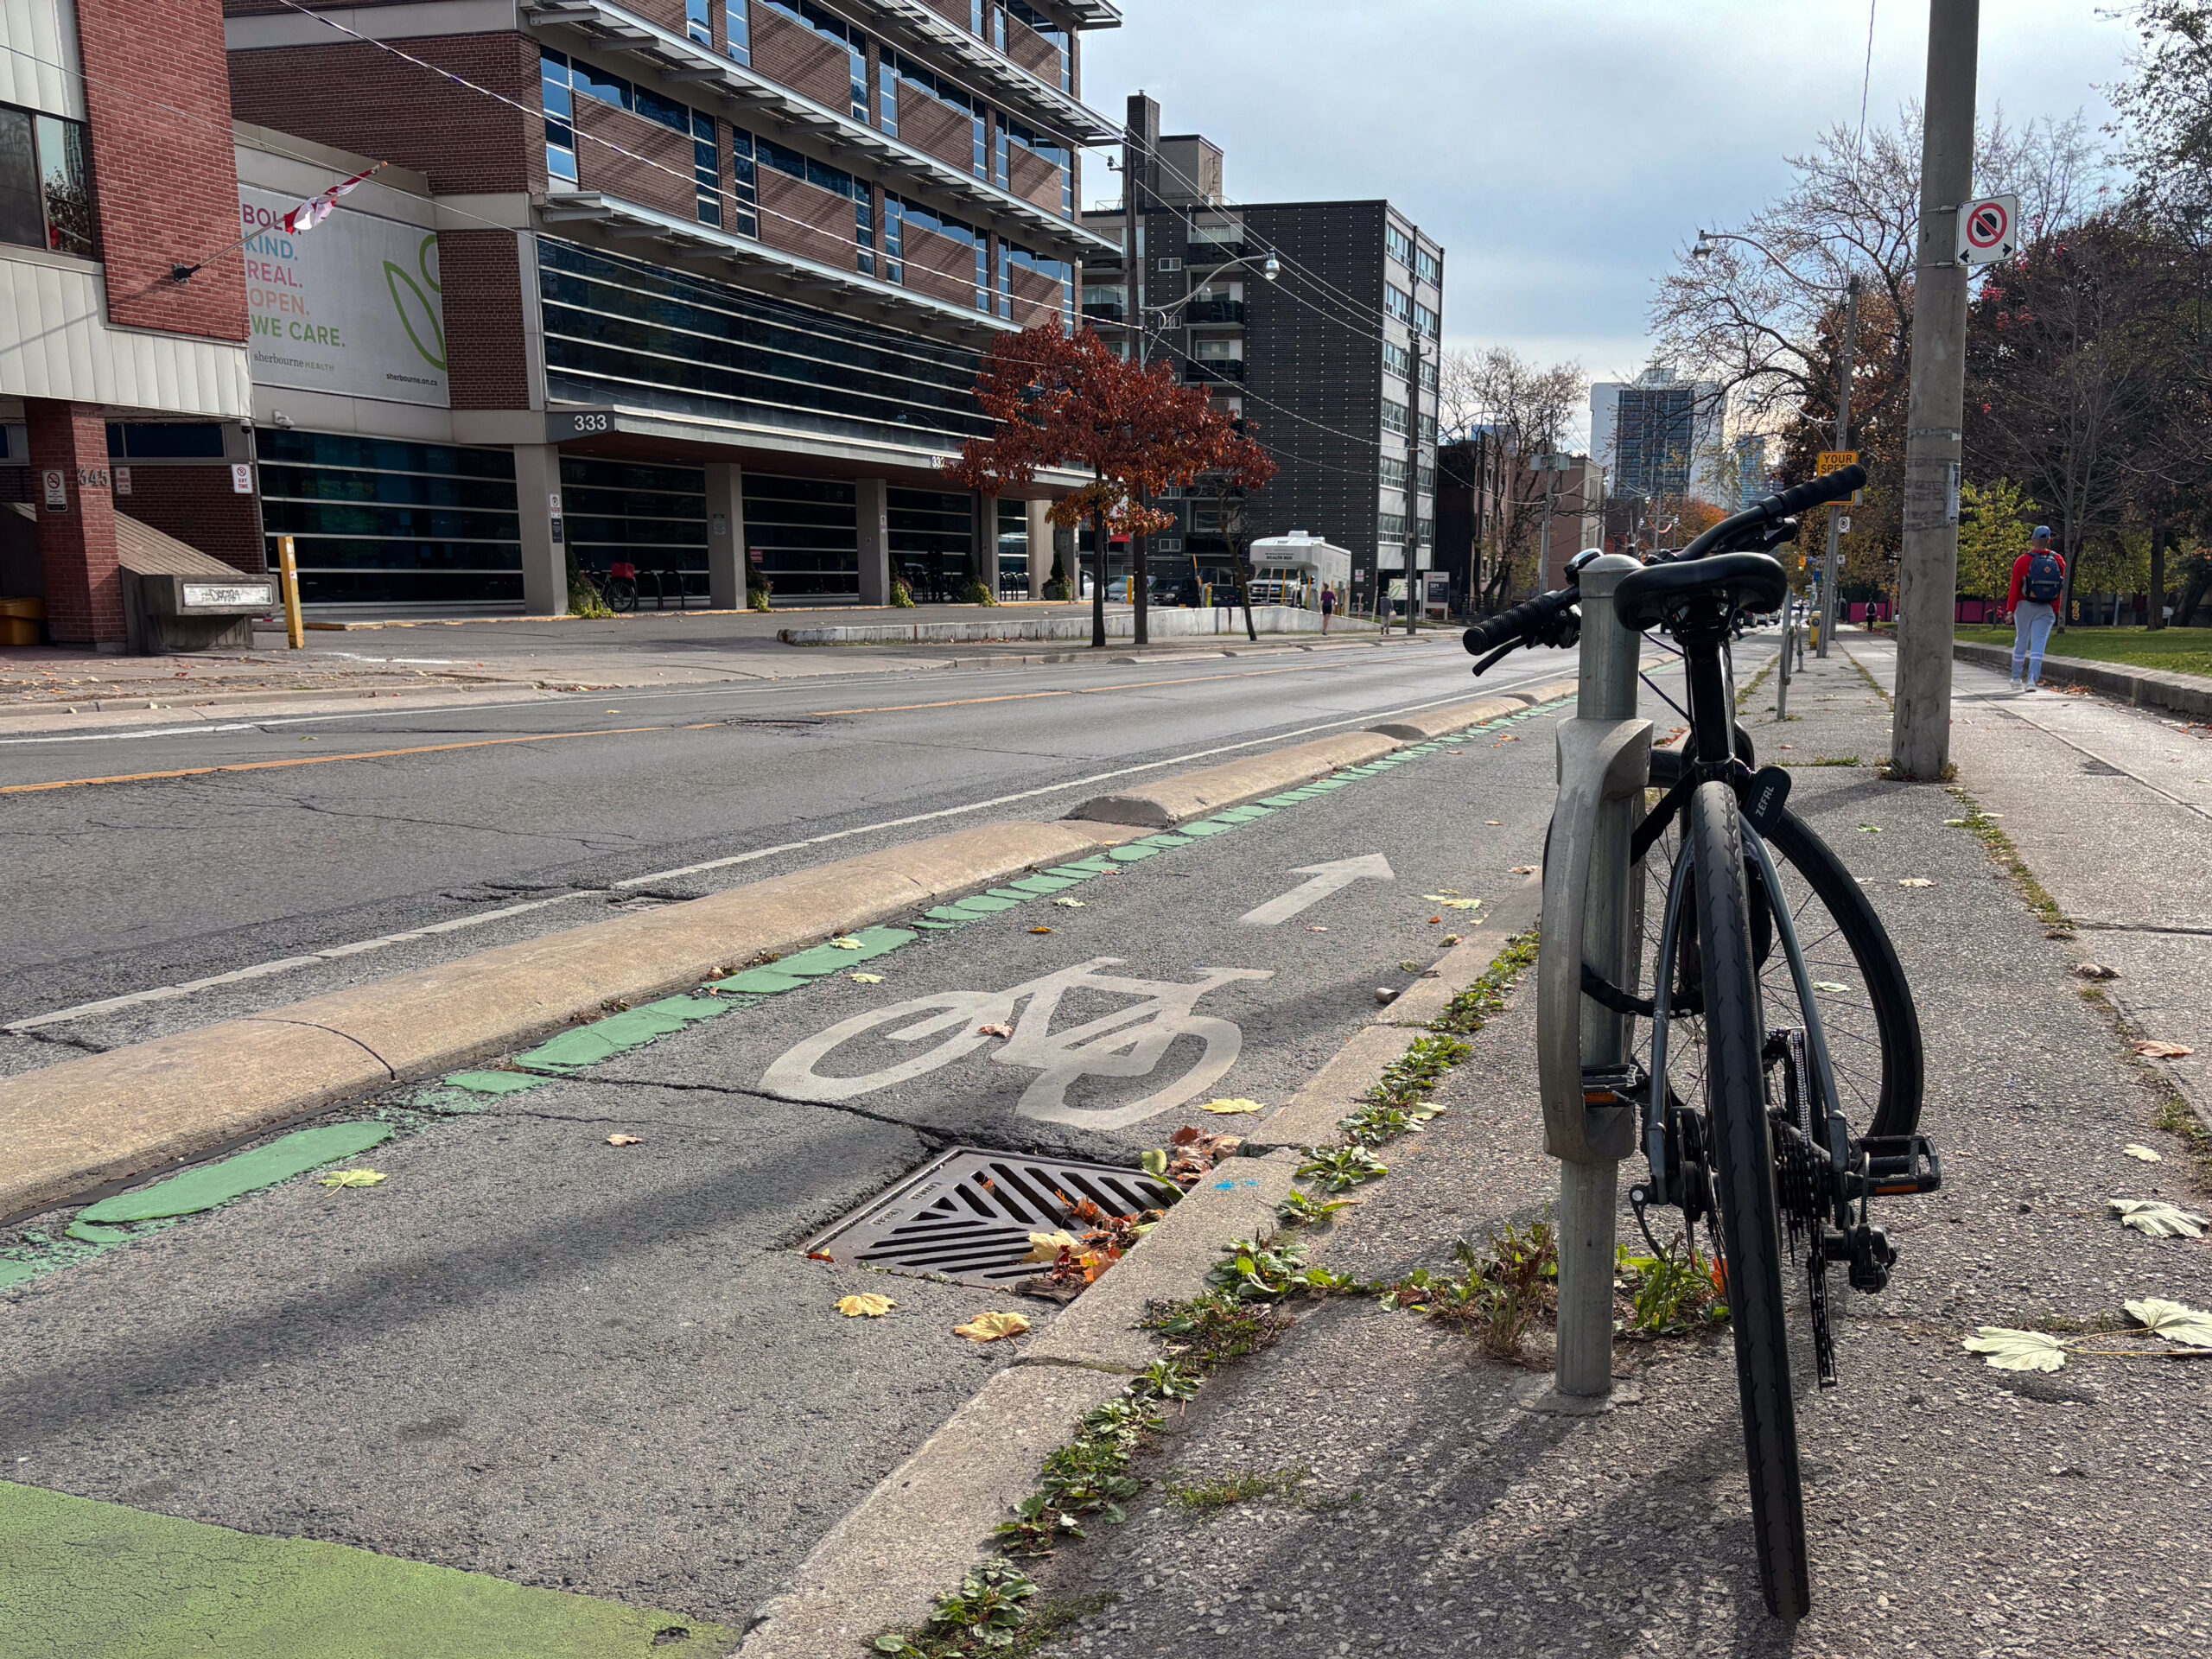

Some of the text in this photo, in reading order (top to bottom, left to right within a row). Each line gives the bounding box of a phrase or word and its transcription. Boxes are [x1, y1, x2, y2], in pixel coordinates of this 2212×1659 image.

[242, 203, 302, 236] BOL.
[245, 231, 298, 262] KIND.
[246, 258, 302, 289] REAL.
[249, 287, 310, 317] OPEN.
[251, 314, 346, 348] WE CARE.
[386, 372, 438, 387] sherbourne.on.ca
[574, 414, 607, 430] 333
[1823, 454, 1853, 464] YOUR
[79, 468, 107, 486] 345
[1754, 785, 1775, 817] ZEFAL
